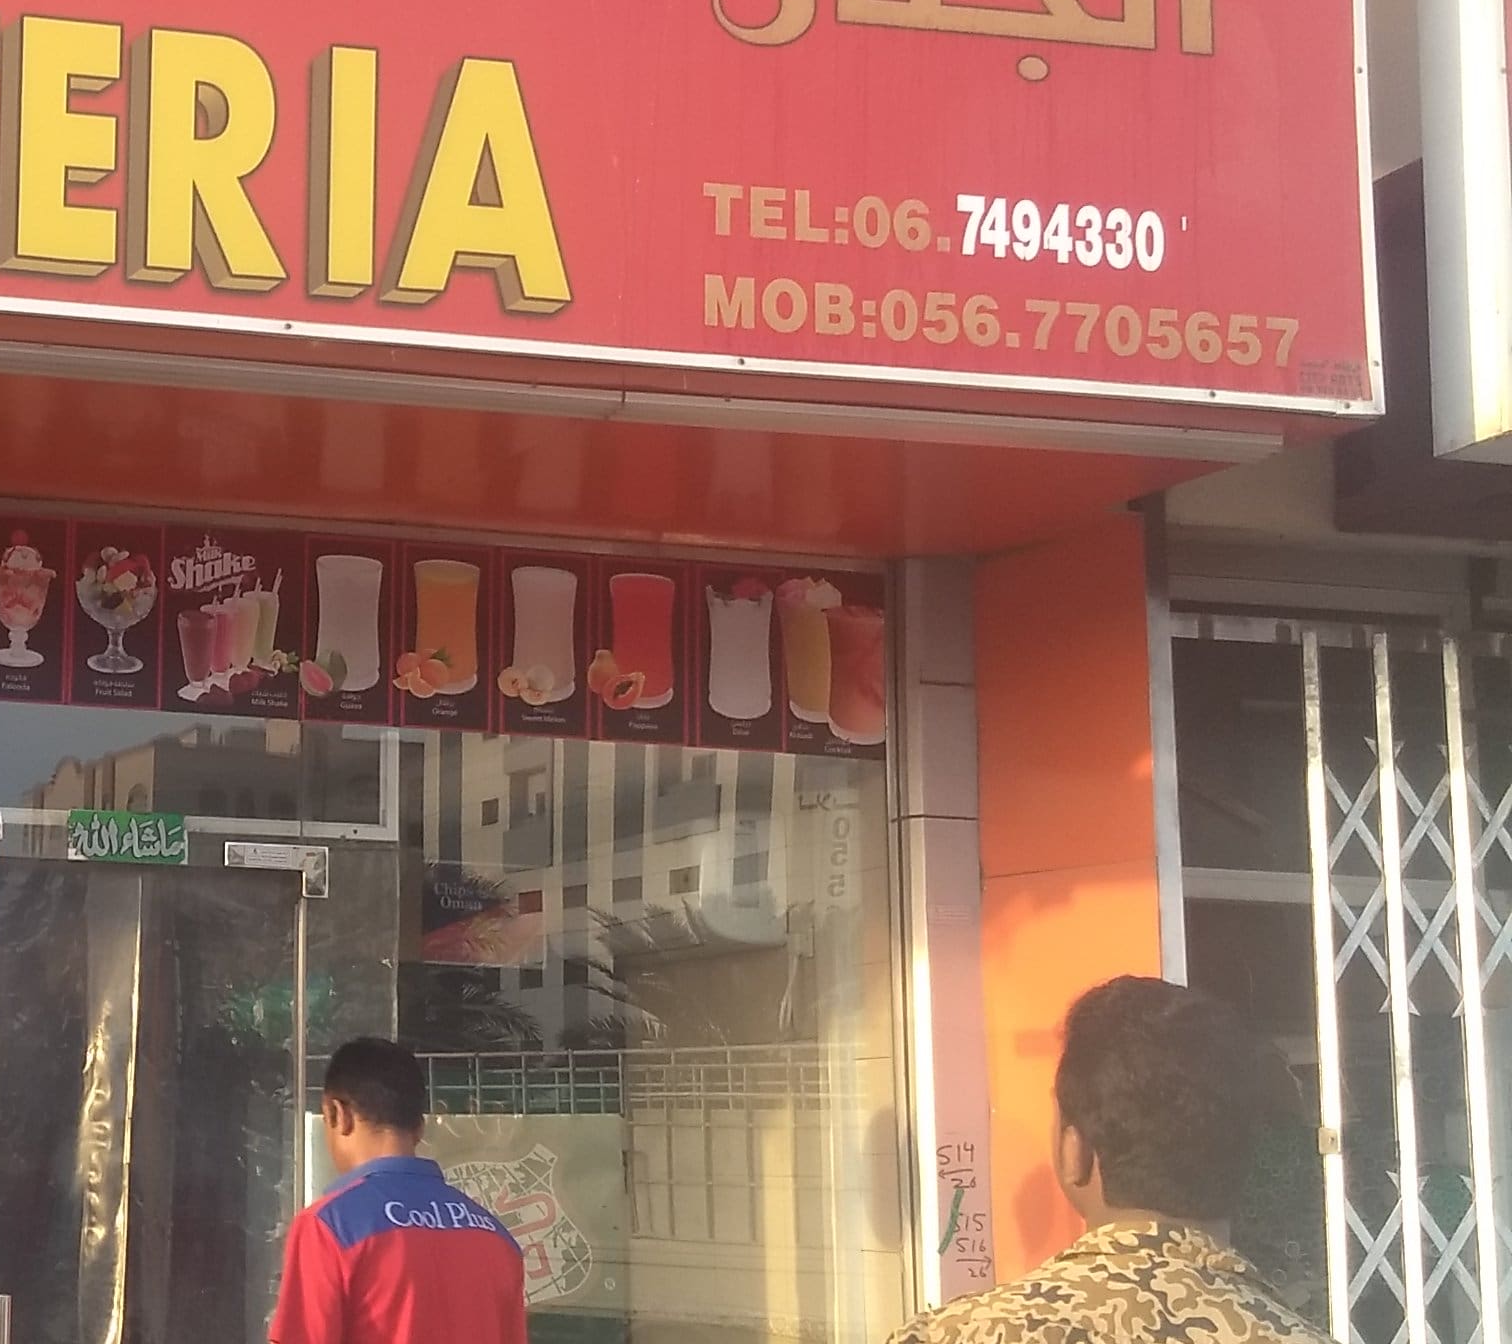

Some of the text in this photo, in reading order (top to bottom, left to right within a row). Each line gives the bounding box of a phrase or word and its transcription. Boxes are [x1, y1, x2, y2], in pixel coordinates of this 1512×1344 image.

[703, 274, 1299, 367] MOB:056.7705657
[168, 552, 256, 590] Shake
[384, 1201, 496, 1232] Cool Plus
